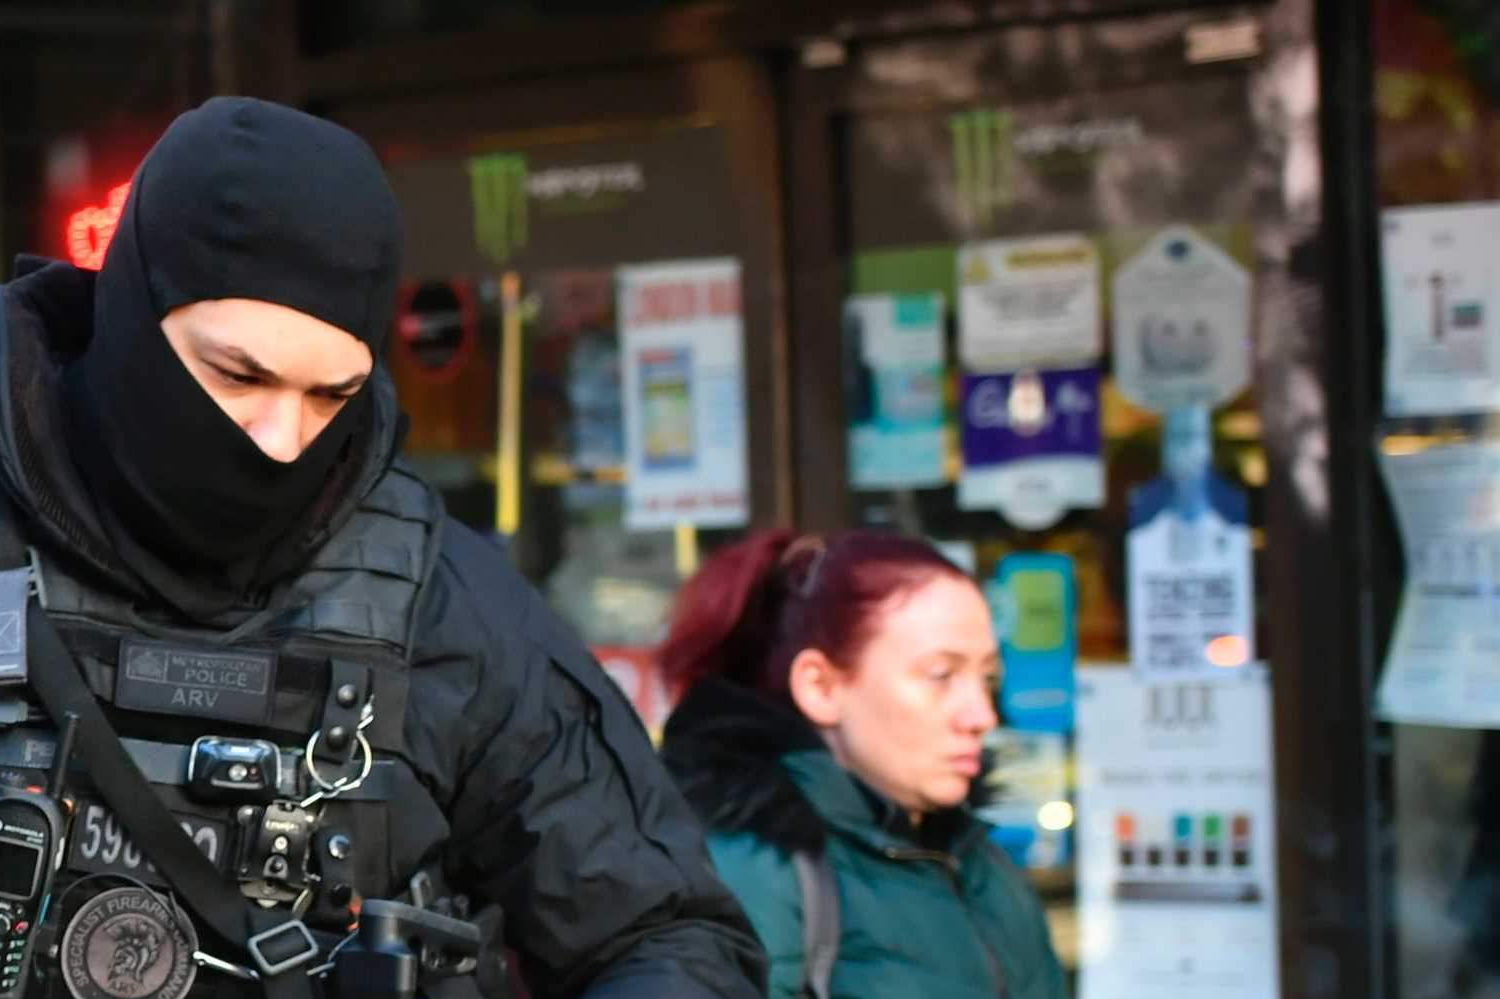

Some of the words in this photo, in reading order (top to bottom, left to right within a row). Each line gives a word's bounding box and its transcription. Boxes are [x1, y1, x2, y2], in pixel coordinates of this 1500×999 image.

[184, 669, 248, 687] POLICE
[171, 688, 220, 707] ARV
[70, 907, 106, 987] SPECIALIST
